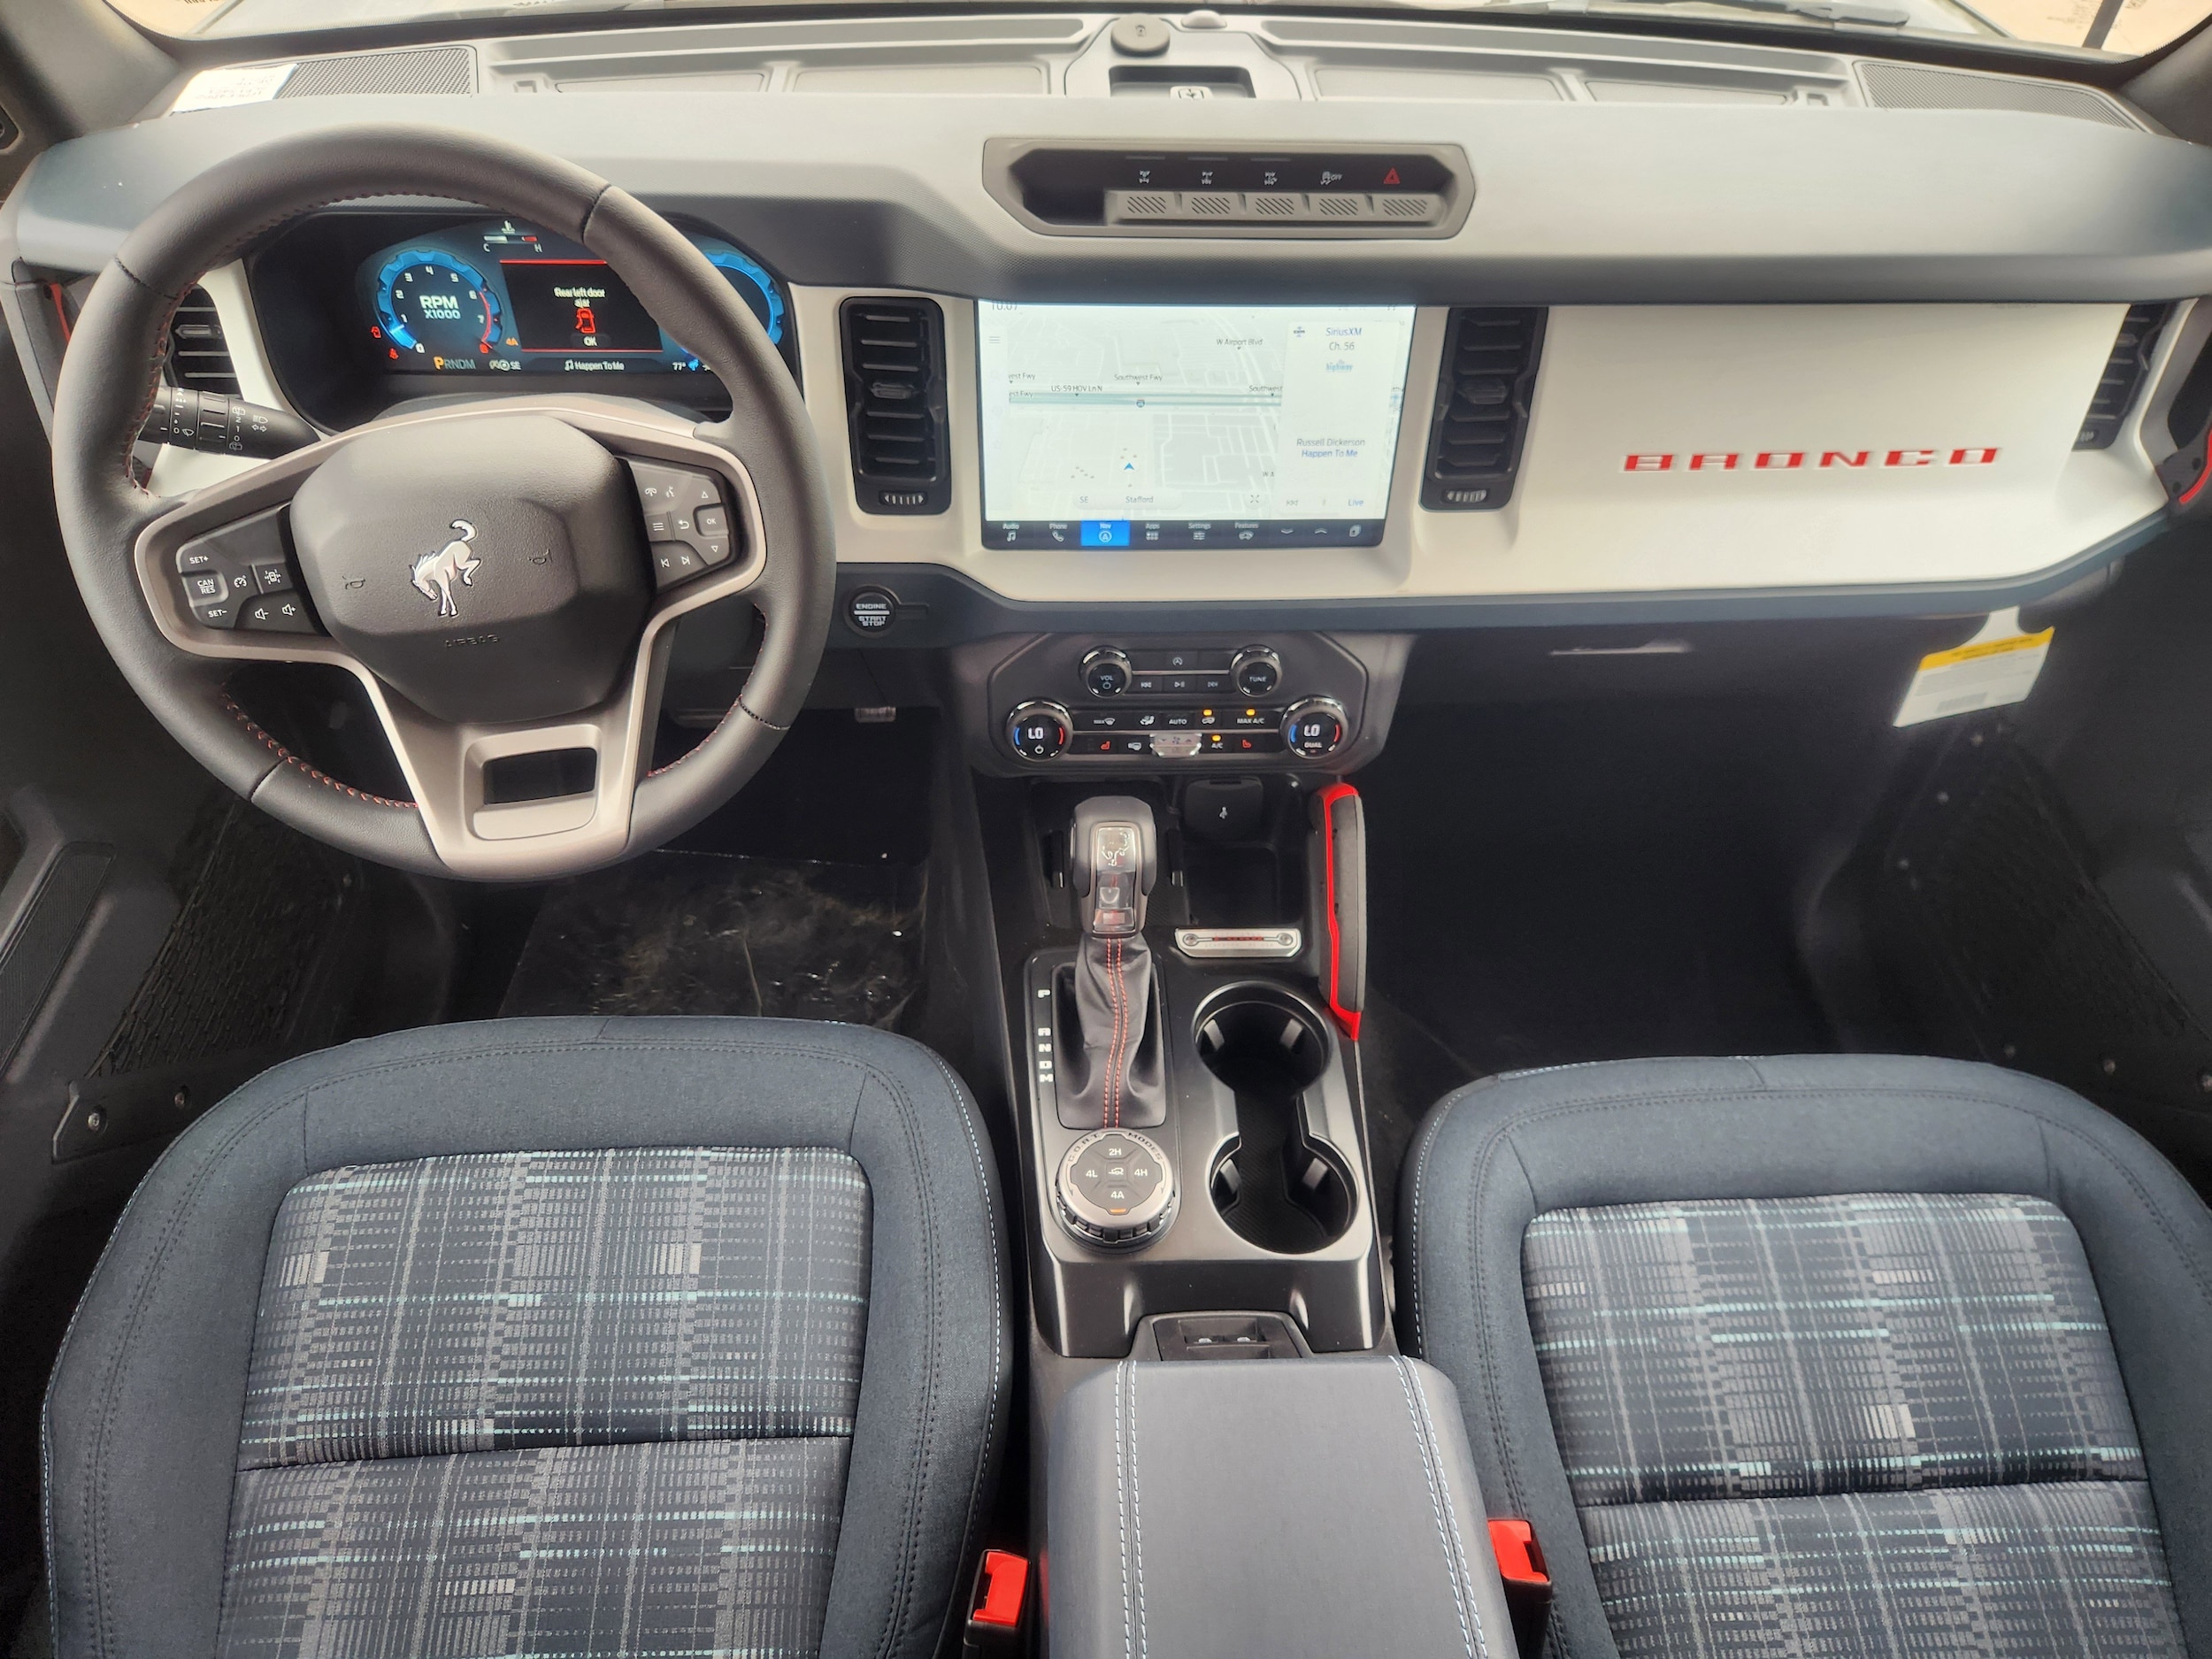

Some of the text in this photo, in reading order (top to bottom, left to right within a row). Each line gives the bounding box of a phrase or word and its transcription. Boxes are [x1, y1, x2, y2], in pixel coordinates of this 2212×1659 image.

[534, 244, 542, 253] H
[426, 265, 434, 275] 4
[404, 273, 413, 282] 3
[450, 273, 459, 282] 5
[396, 289, 404, 299] 2
[469, 290, 477, 299] 6
[554, 287, 606, 298] Rear left door
[419, 295, 459, 310] RPM
[401, 314, 408, 323] 1
[424, 310, 461, 319] X1000
[478, 315, 485, 324] 7
[1325, 327, 1363, 336] SiriusXM
[584, 336, 598, 347] OK
[1329, 342, 1355, 350] Ch. 56
[415, 342, 425, 354] 0
[575, 361, 603, 373] Happen
[1149, 373, 1163, 382] Fwy
[1297, 438, 1365, 447] Russell Dickerson
[1302, 449, 1333, 458] Happen
[1623, 447, 2001, 472] BRONCO
[1188, 522, 1211, 531] Settings
[189, 556, 209, 565] SET+
[1027, 727, 1044, 740] LO
[1304, 724, 1321, 737] LO
[1037, 989, 1051, 998] P
[1038, 1043, 1052, 1052] N
[1039, 1060, 1053, 1069] D
[1039, 1073, 1054, 1082] M
[1127, 1133, 1164, 1161] MODES
